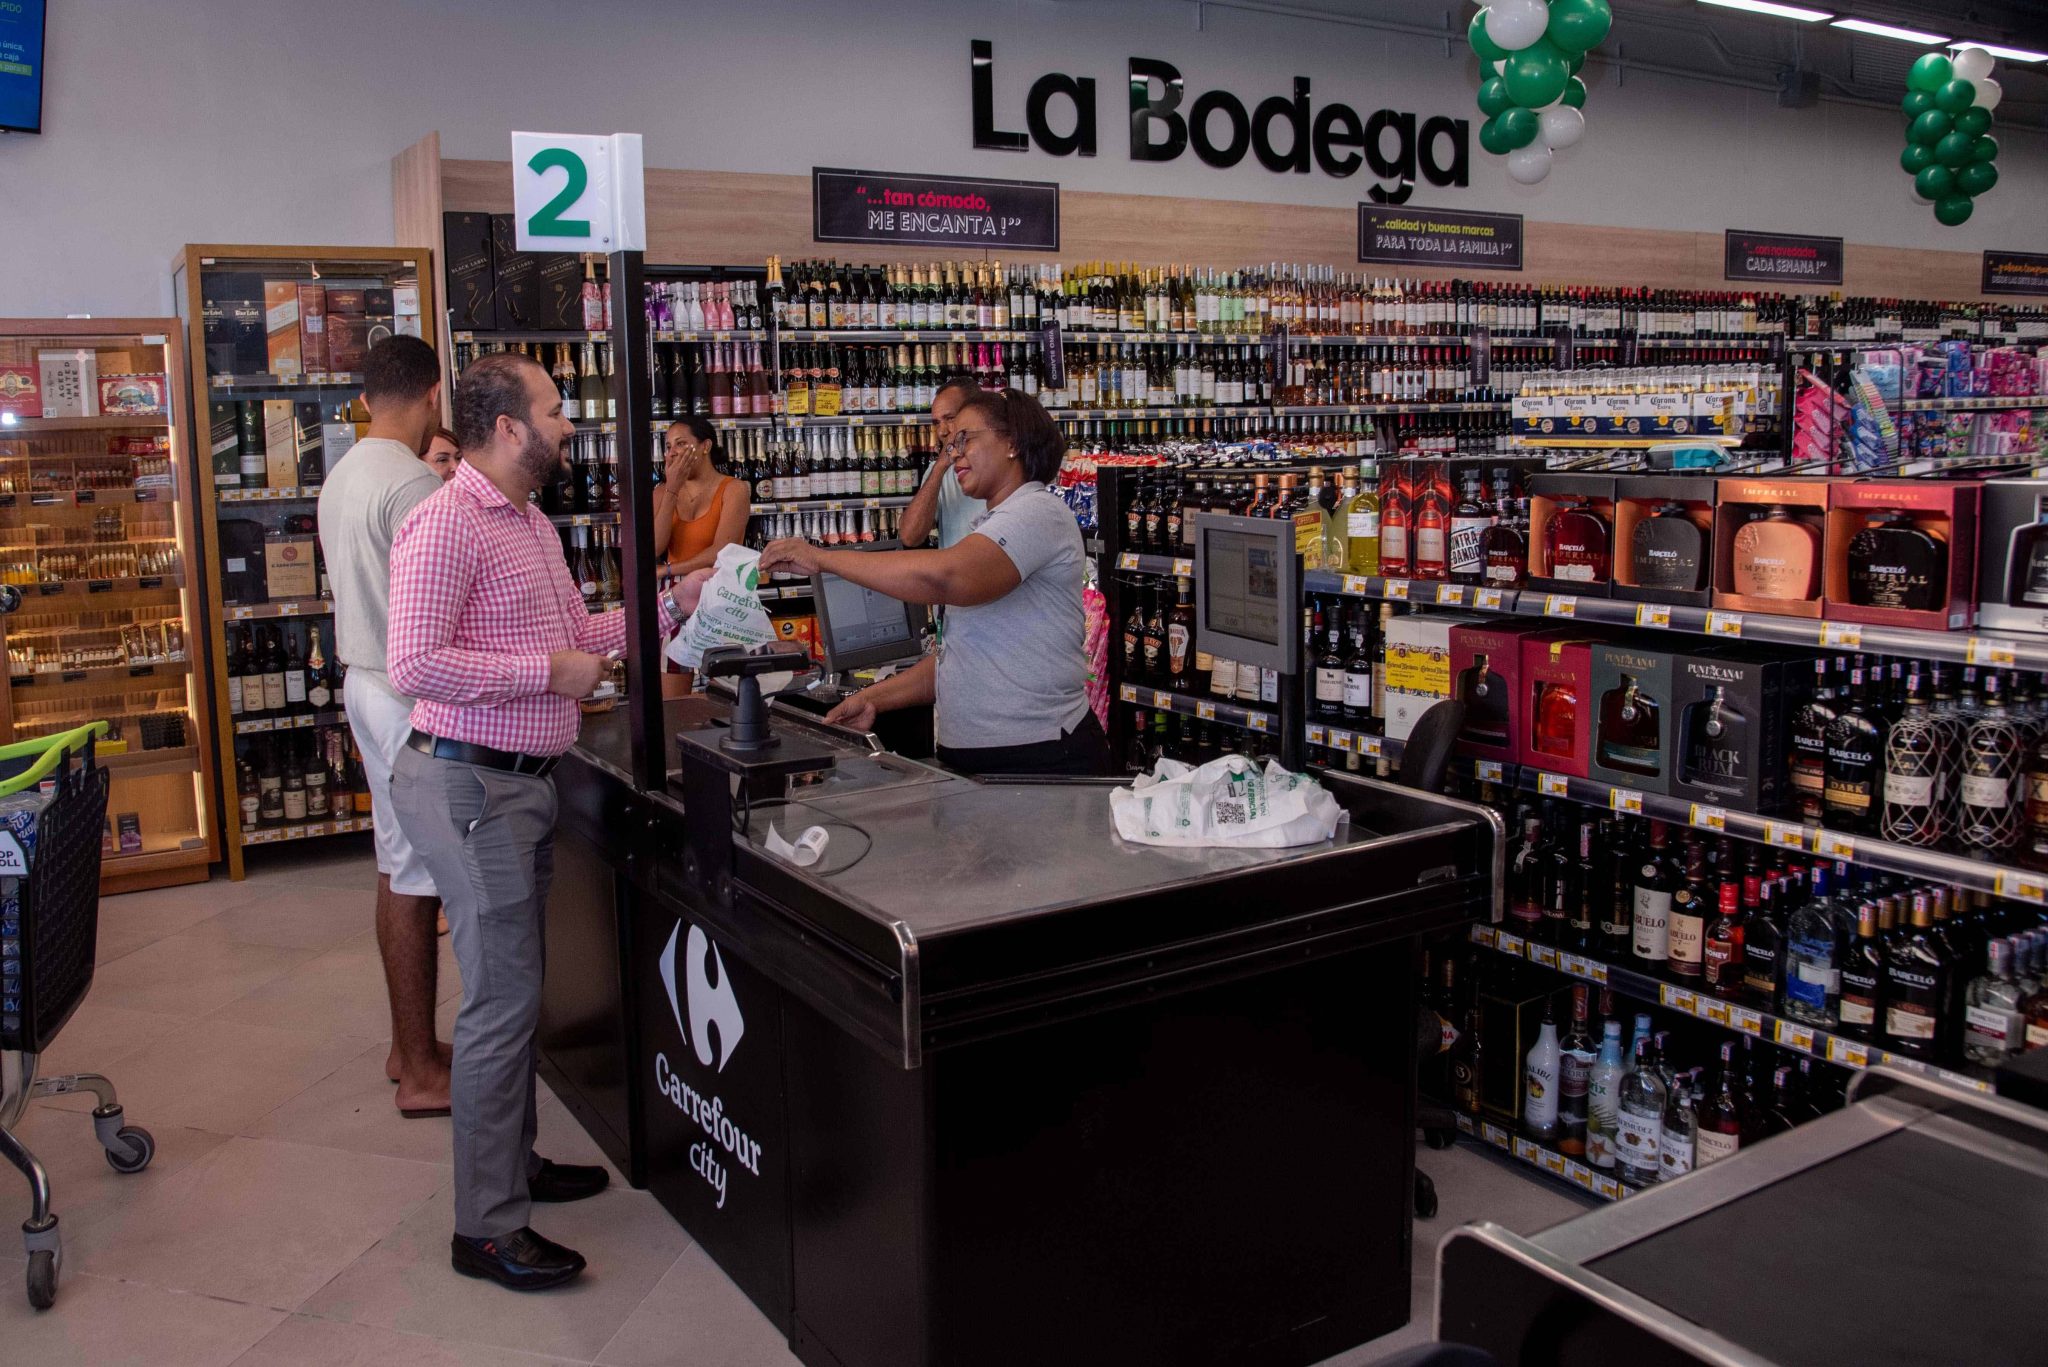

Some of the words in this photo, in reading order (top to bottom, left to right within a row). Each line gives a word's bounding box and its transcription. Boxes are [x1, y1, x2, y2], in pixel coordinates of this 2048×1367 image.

[972, 39, 1097, 156] La
[1128, 56, 1470, 204] Bodega
[527, 147, 591, 238] 2
[917, 189, 992, 213] cómodo,
[867, 210, 895, 231] ME
[900, 212, 997, 236] ENCANTA
[1421, 222, 1427, 235] y
[1427, 221, 1461, 234] buenas
[1461, 225, 1495, 237] marcas
[1376, 235, 1406, 250] PARA
[1408, 237, 1441, 252] TODA
[1443, 240, 1457, 253] LA
[1459, 241, 1499, 256] FAMILIA
[451, 263, 468, 273] BLACK
[470, 256, 488, 268] LABEL
[498, 265, 516, 276] BLACK
[517, 258, 535, 270] LABEL
[540, 266, 557, 276] BLACK
[1746, 257, 1775, 272] CADA
[1775, 259, 1815, 274] SEMANA
[65, 361, 73, 407] LIMITED
[72, 370, 80, 397] RARE
[1743, 488, 1799, 497] IMPERIAL
[1858, 492, 1920, 501] IMPERIAL
[725, 605, 750, 622] city
[1828, 747, 1873, 761] BARCELÓ
[1830, 781, 1864, 794] DARK
[655, 1052, 762, 1177] Carrefour
[689, 1141, 727, 1209] city
